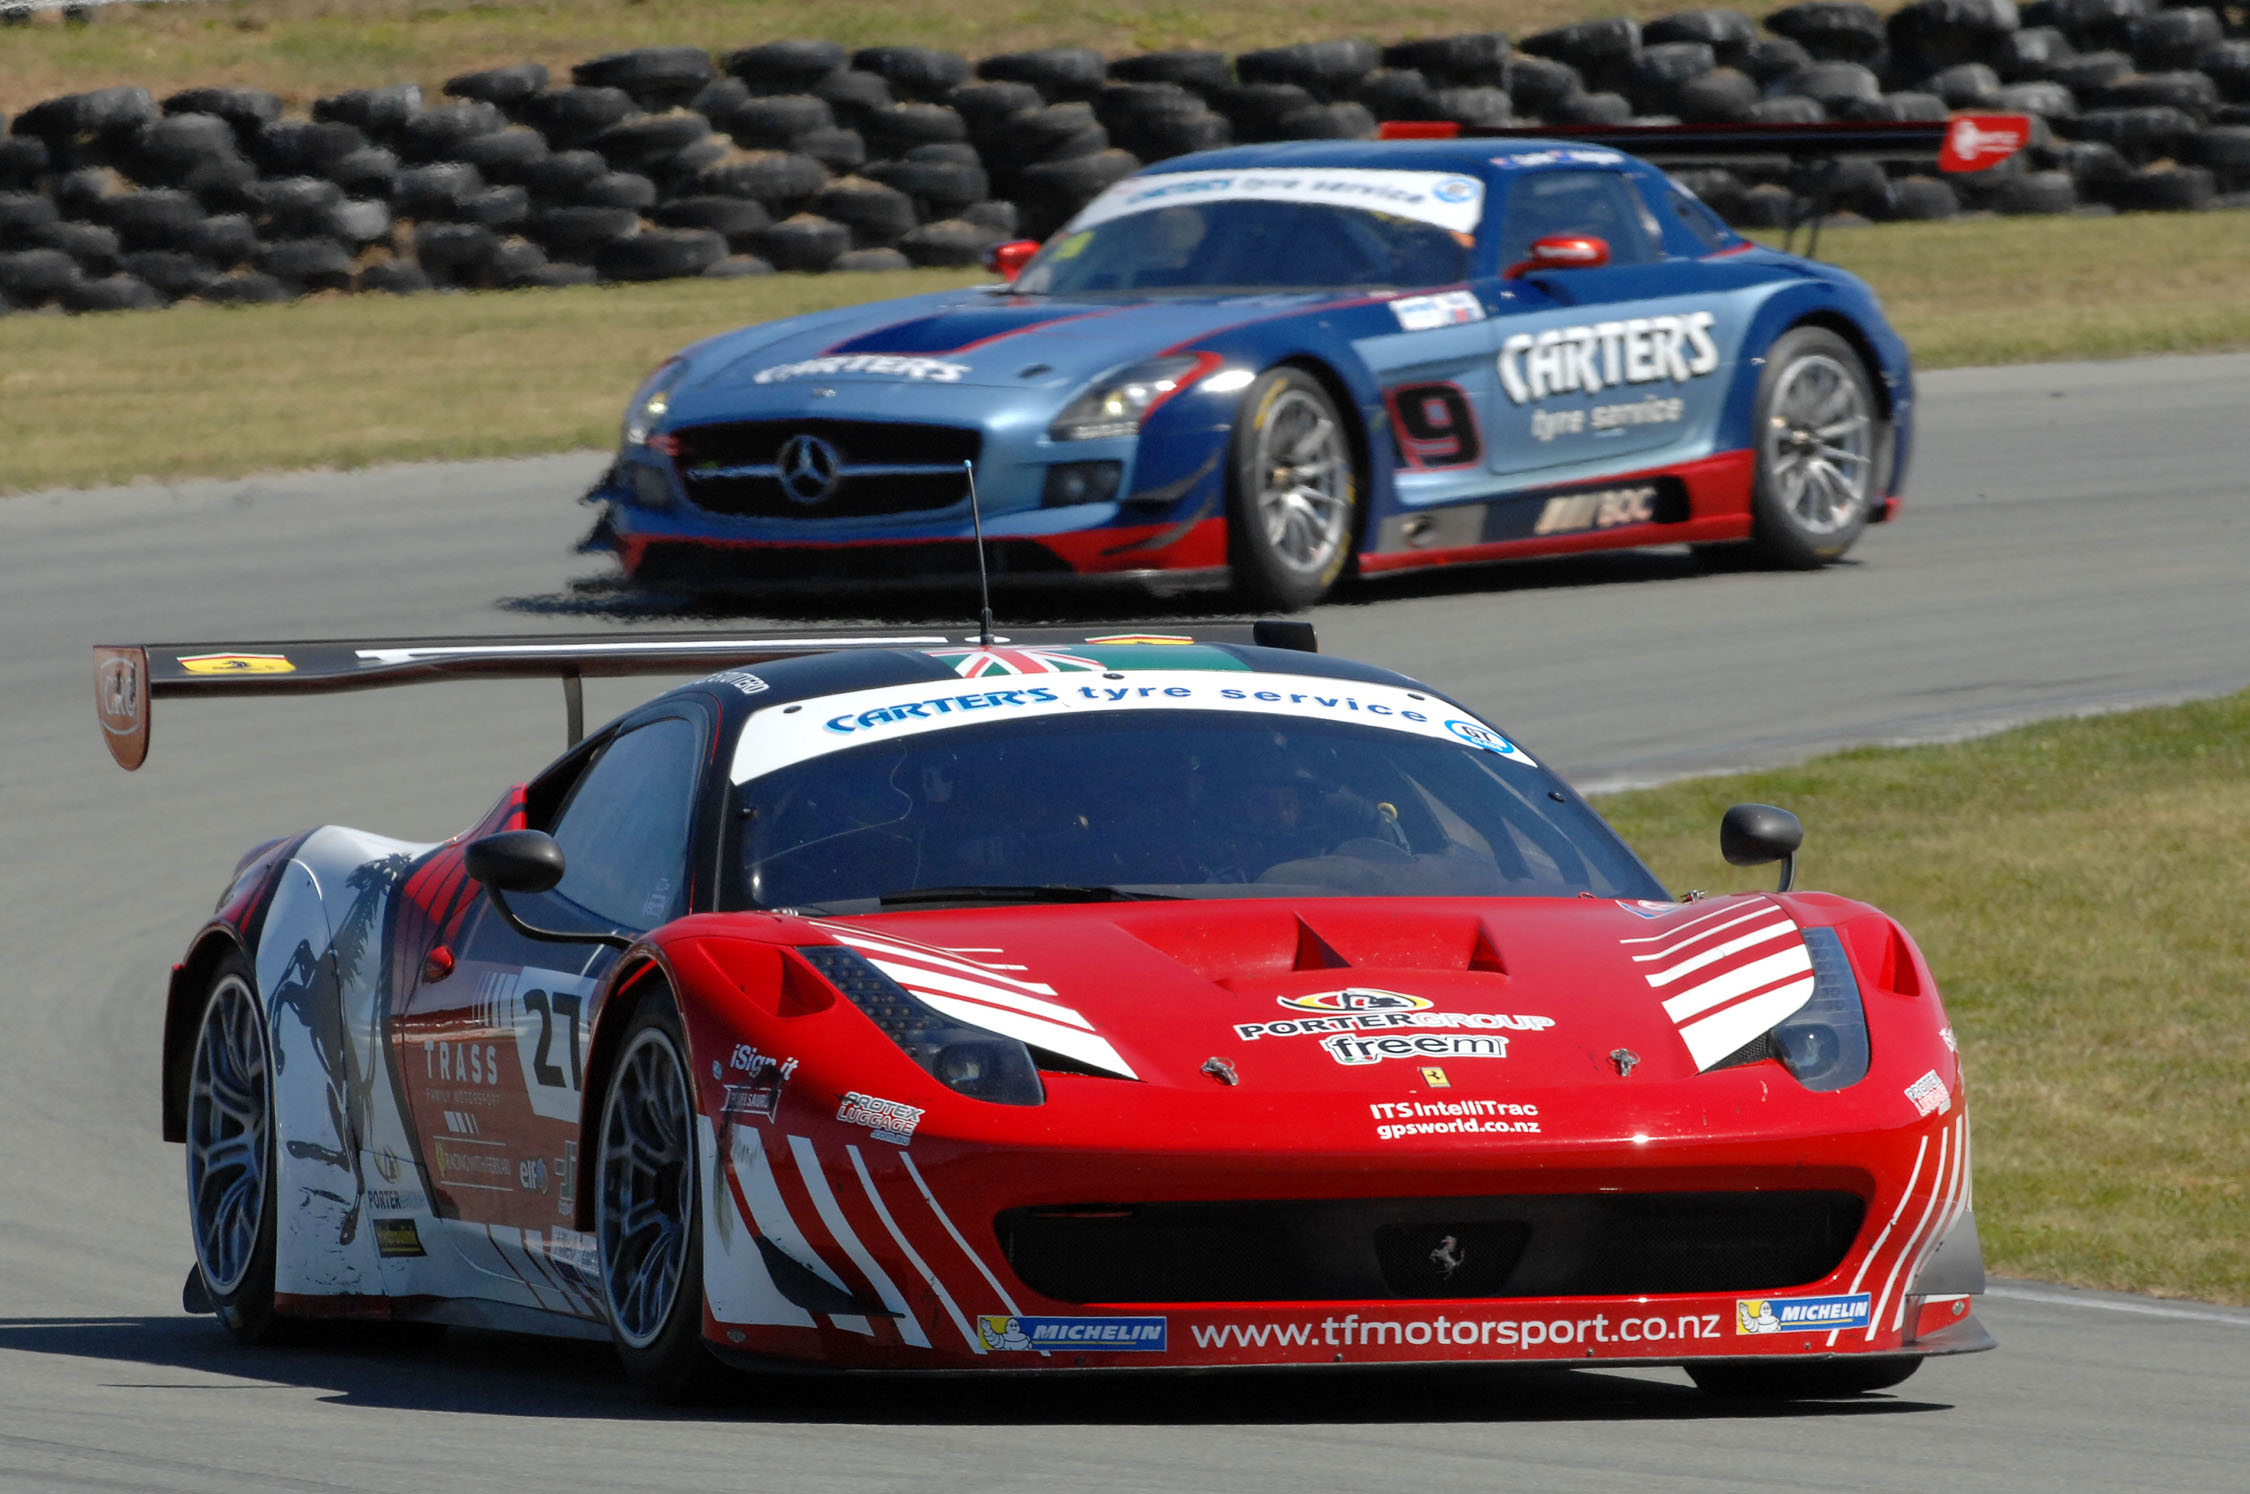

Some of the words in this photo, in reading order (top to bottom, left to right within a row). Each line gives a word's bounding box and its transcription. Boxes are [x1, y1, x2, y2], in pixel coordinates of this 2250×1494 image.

[1392, 384, 1482, 468] 9
[1531, 409, 1586, 442] tyre
[825, 687, 1059, 734] CARTER'S
[1078, 686, 1191, 701] tyre
[1221, 688, 1429, 723] service
[523, 988, 582, 1093] 27
[1330, 1035, 1499, 1061] freem
[424, 1039, 498, 1085] TRASS
[836, 1104, 917, 1137] LUGGAGE
[842, 1090, 925, 1123] PROTEX
[1369, 1102, 1413, 1120] ITS
[1414, 1100, 1539, 1117] IntelliTrac
[1376, 1118, 1541, 1140] gpsworld.co.nz
[519, 1159, 537, 1190] elf
[1781, 1302, 1868, 1322] MICHELIN
[1032, 1324, 1162, 1340] MICHELIN
[1190, 1314, 1721, 1350] www.tfmotorsport.co.nz
